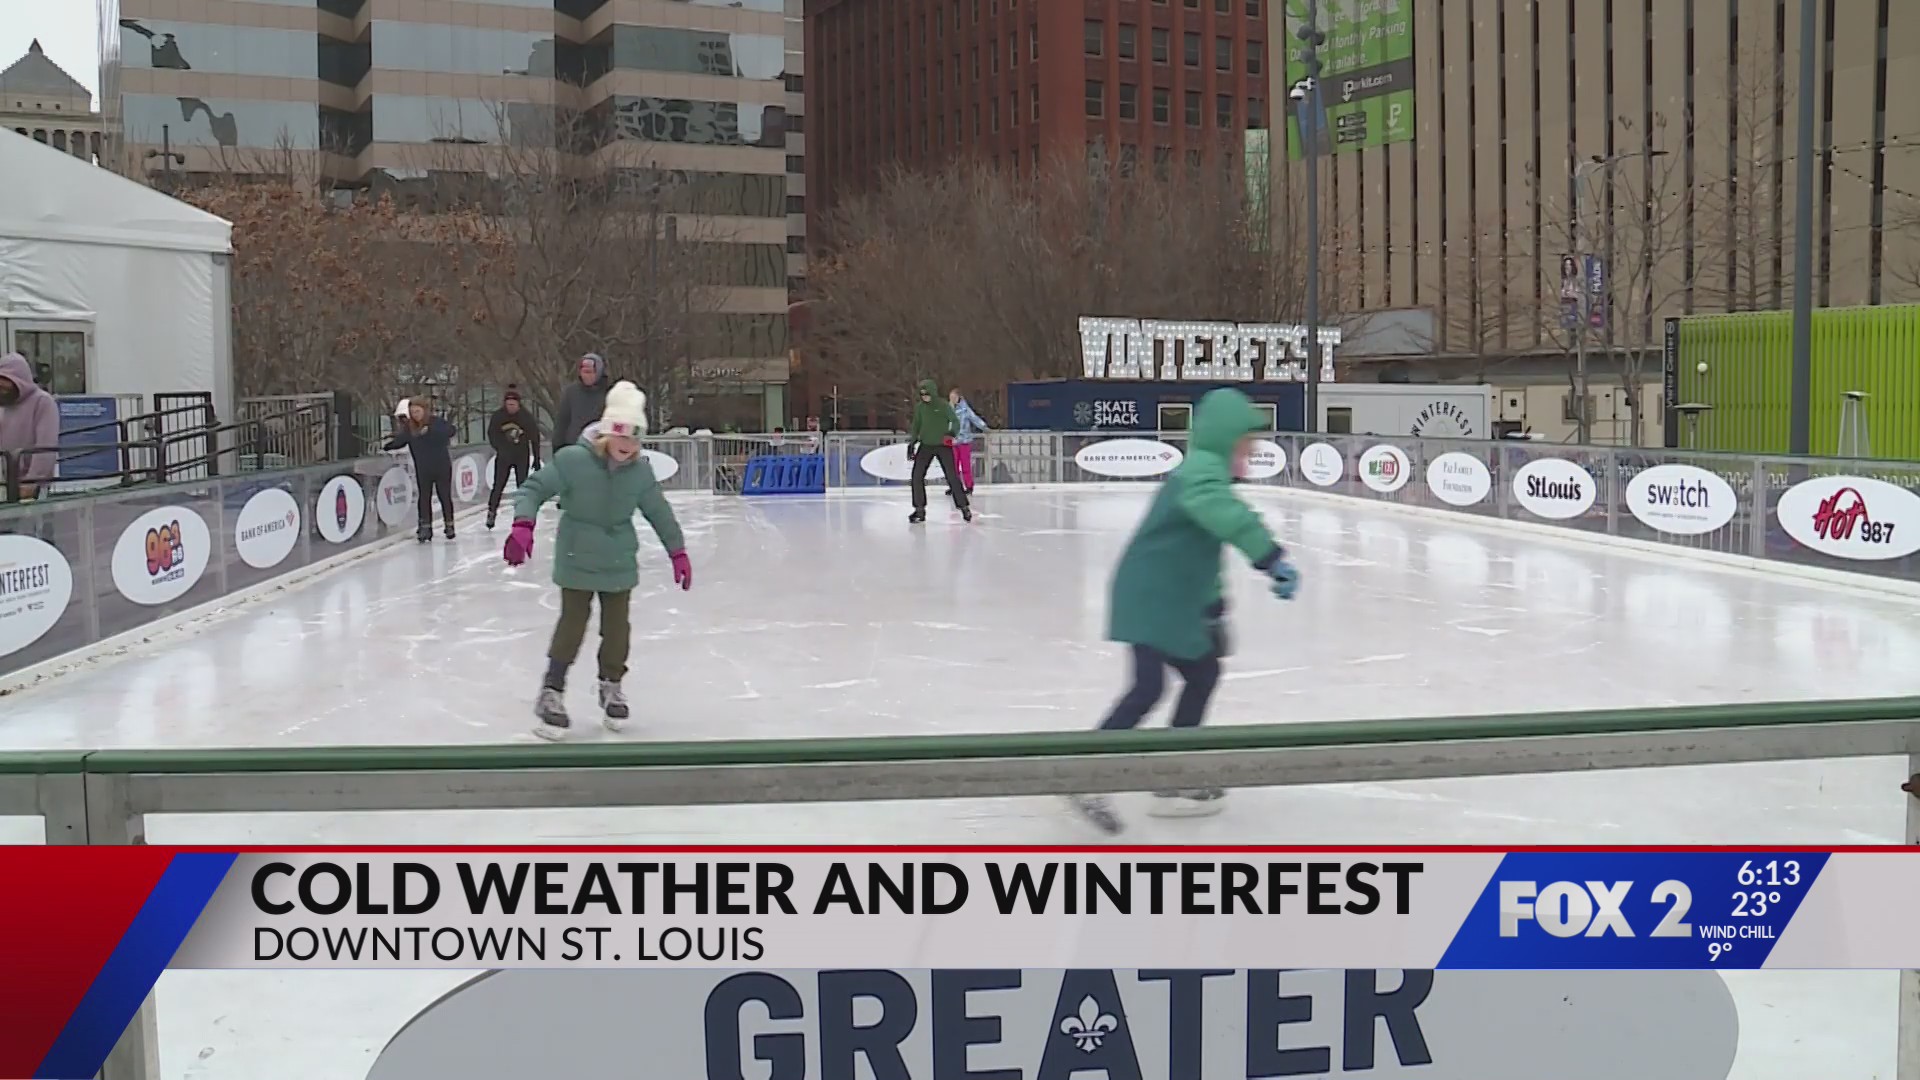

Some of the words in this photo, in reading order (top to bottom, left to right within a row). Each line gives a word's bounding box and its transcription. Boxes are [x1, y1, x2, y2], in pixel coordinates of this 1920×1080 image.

[1369, 21, 1406, 40] Parking
[1079, 316, 1341, 382] WINTERFEST
[1666, 337, 1674, 372] Center
[1094, 400, 1137, 412] SKATE
[1094, 413, 1139, 425] SHACK
[1411, 401, 1472, 437] WINTERFEST
[704, 969, 1434, 1080] GREATER
